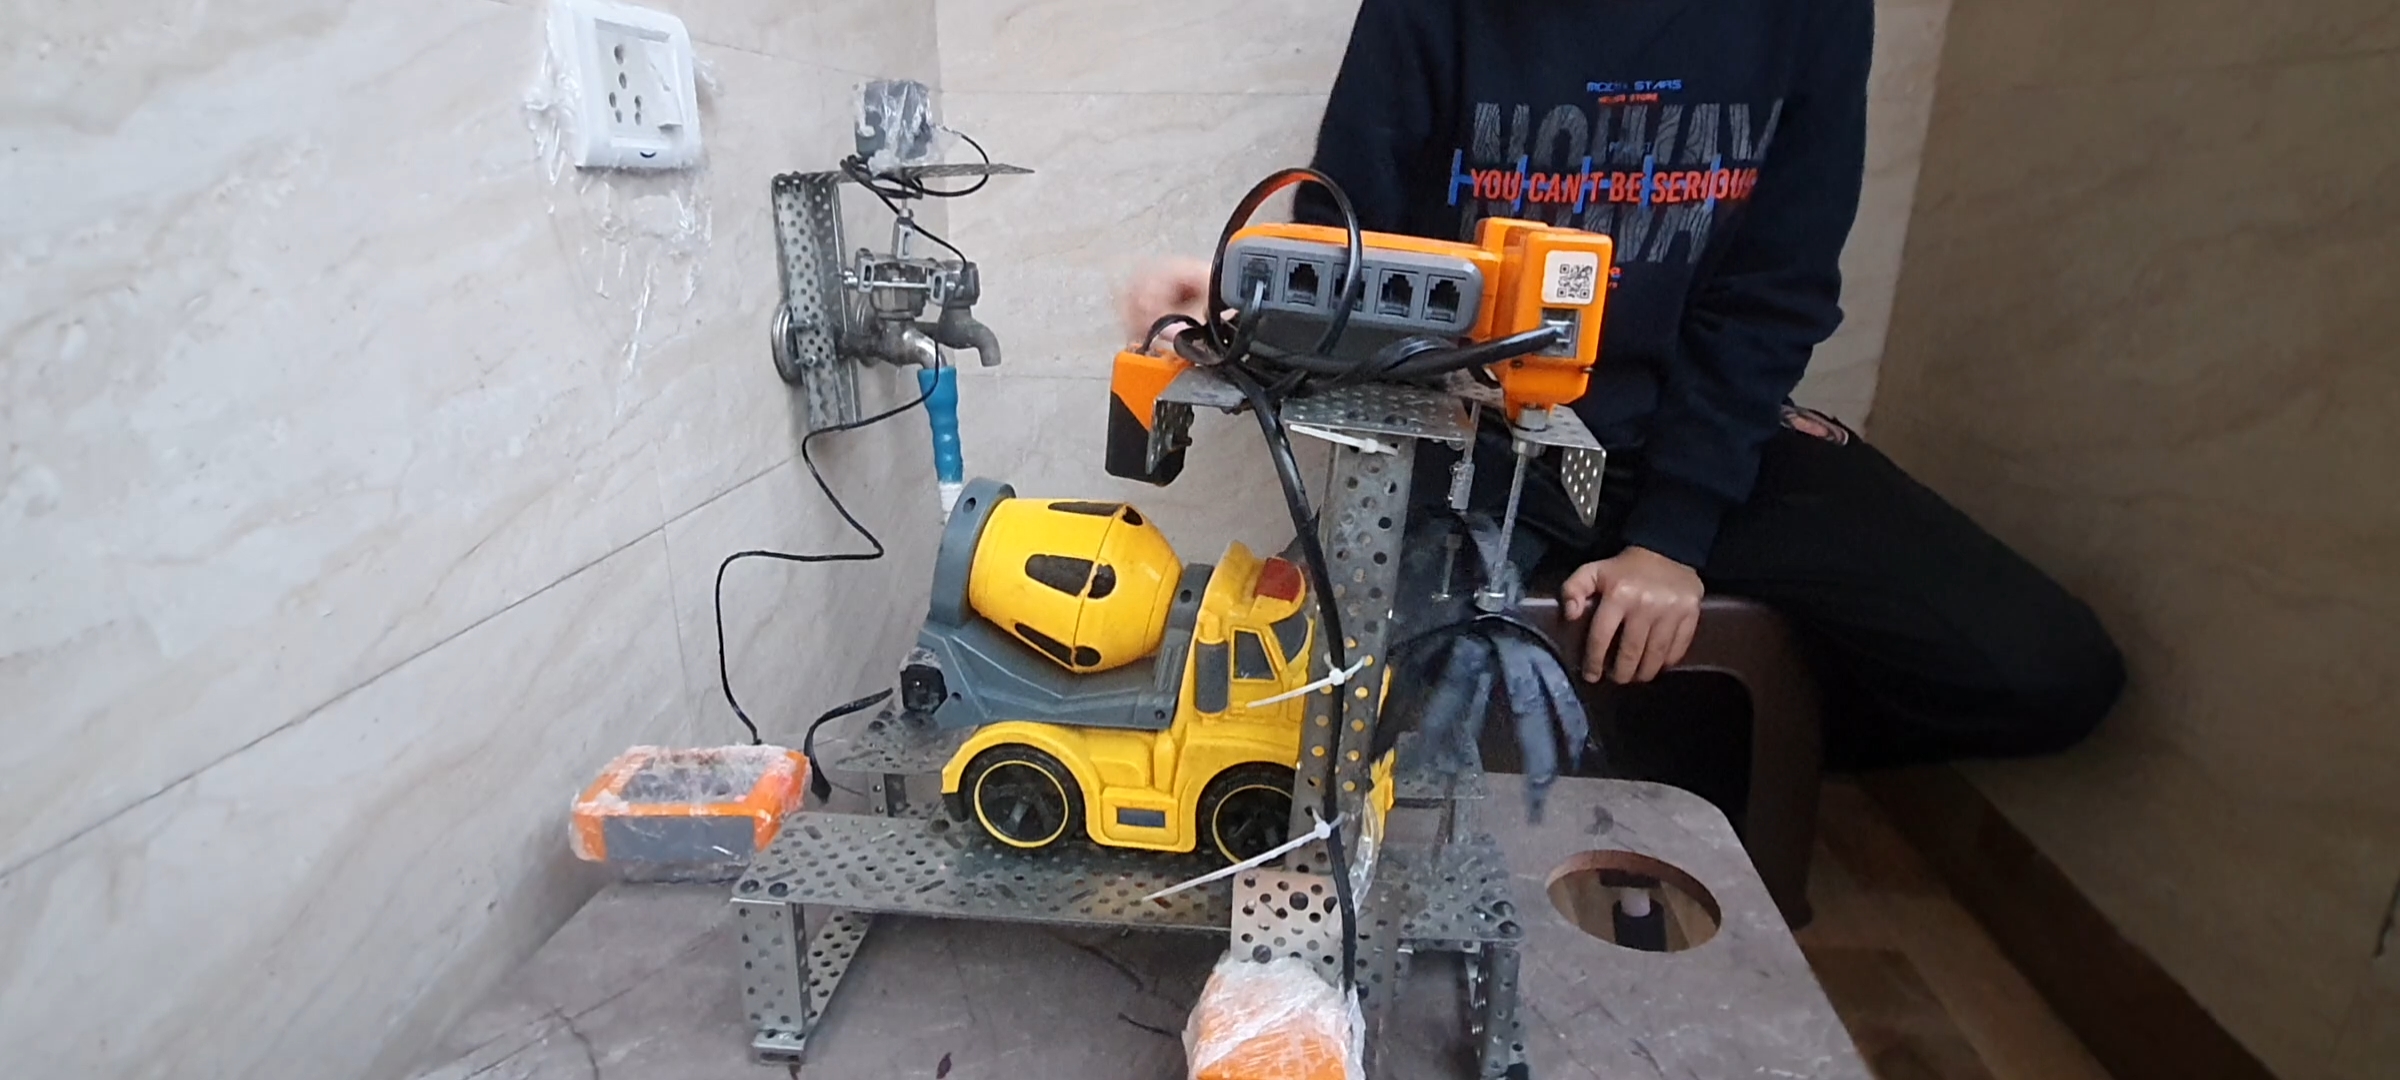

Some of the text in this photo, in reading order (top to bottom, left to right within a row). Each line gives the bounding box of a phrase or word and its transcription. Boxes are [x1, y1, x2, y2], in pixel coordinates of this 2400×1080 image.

[1634, 79, 1682, 91] STARS
[1471, 168, 1522, 200] YOU
[1609, 171, 1644, 202] BE
